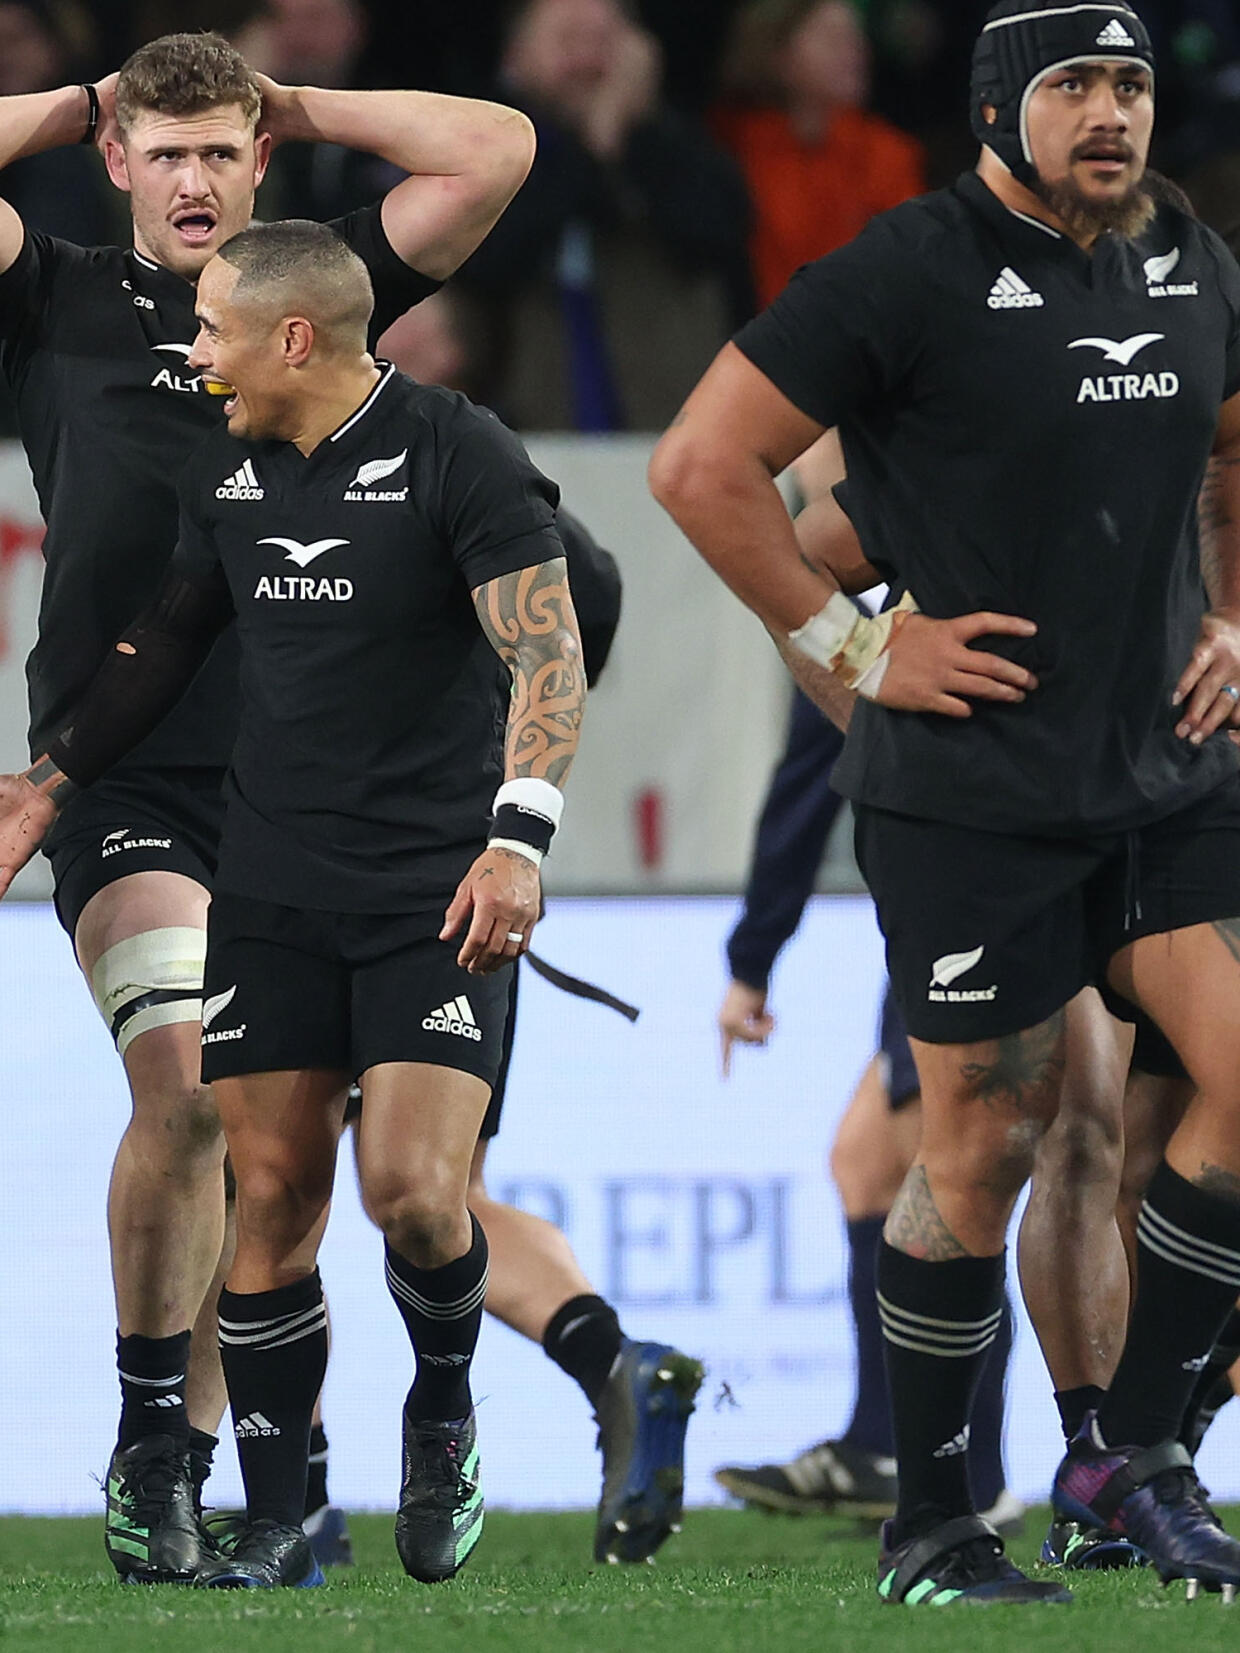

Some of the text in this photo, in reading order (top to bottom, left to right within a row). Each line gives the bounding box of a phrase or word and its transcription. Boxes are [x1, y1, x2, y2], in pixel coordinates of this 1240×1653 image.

[987, 292, 1044, 309] adidas
[151, 368, 202, 393] ALT
[1076, 371, 1179, 403] ALTRAD
[215, 485, 264, 500] adidas
[343, 490, 406, 501] ALL BLACKS
[254, 576, 354, 601] ALTRAD
[102, 838, 171, 858] ALL BLACKS
[947, 989, 996, 1002] BLACKS
[207, 1028, 244, 1043] BLACKS
[422, 1016, 482, 1042] adidas
